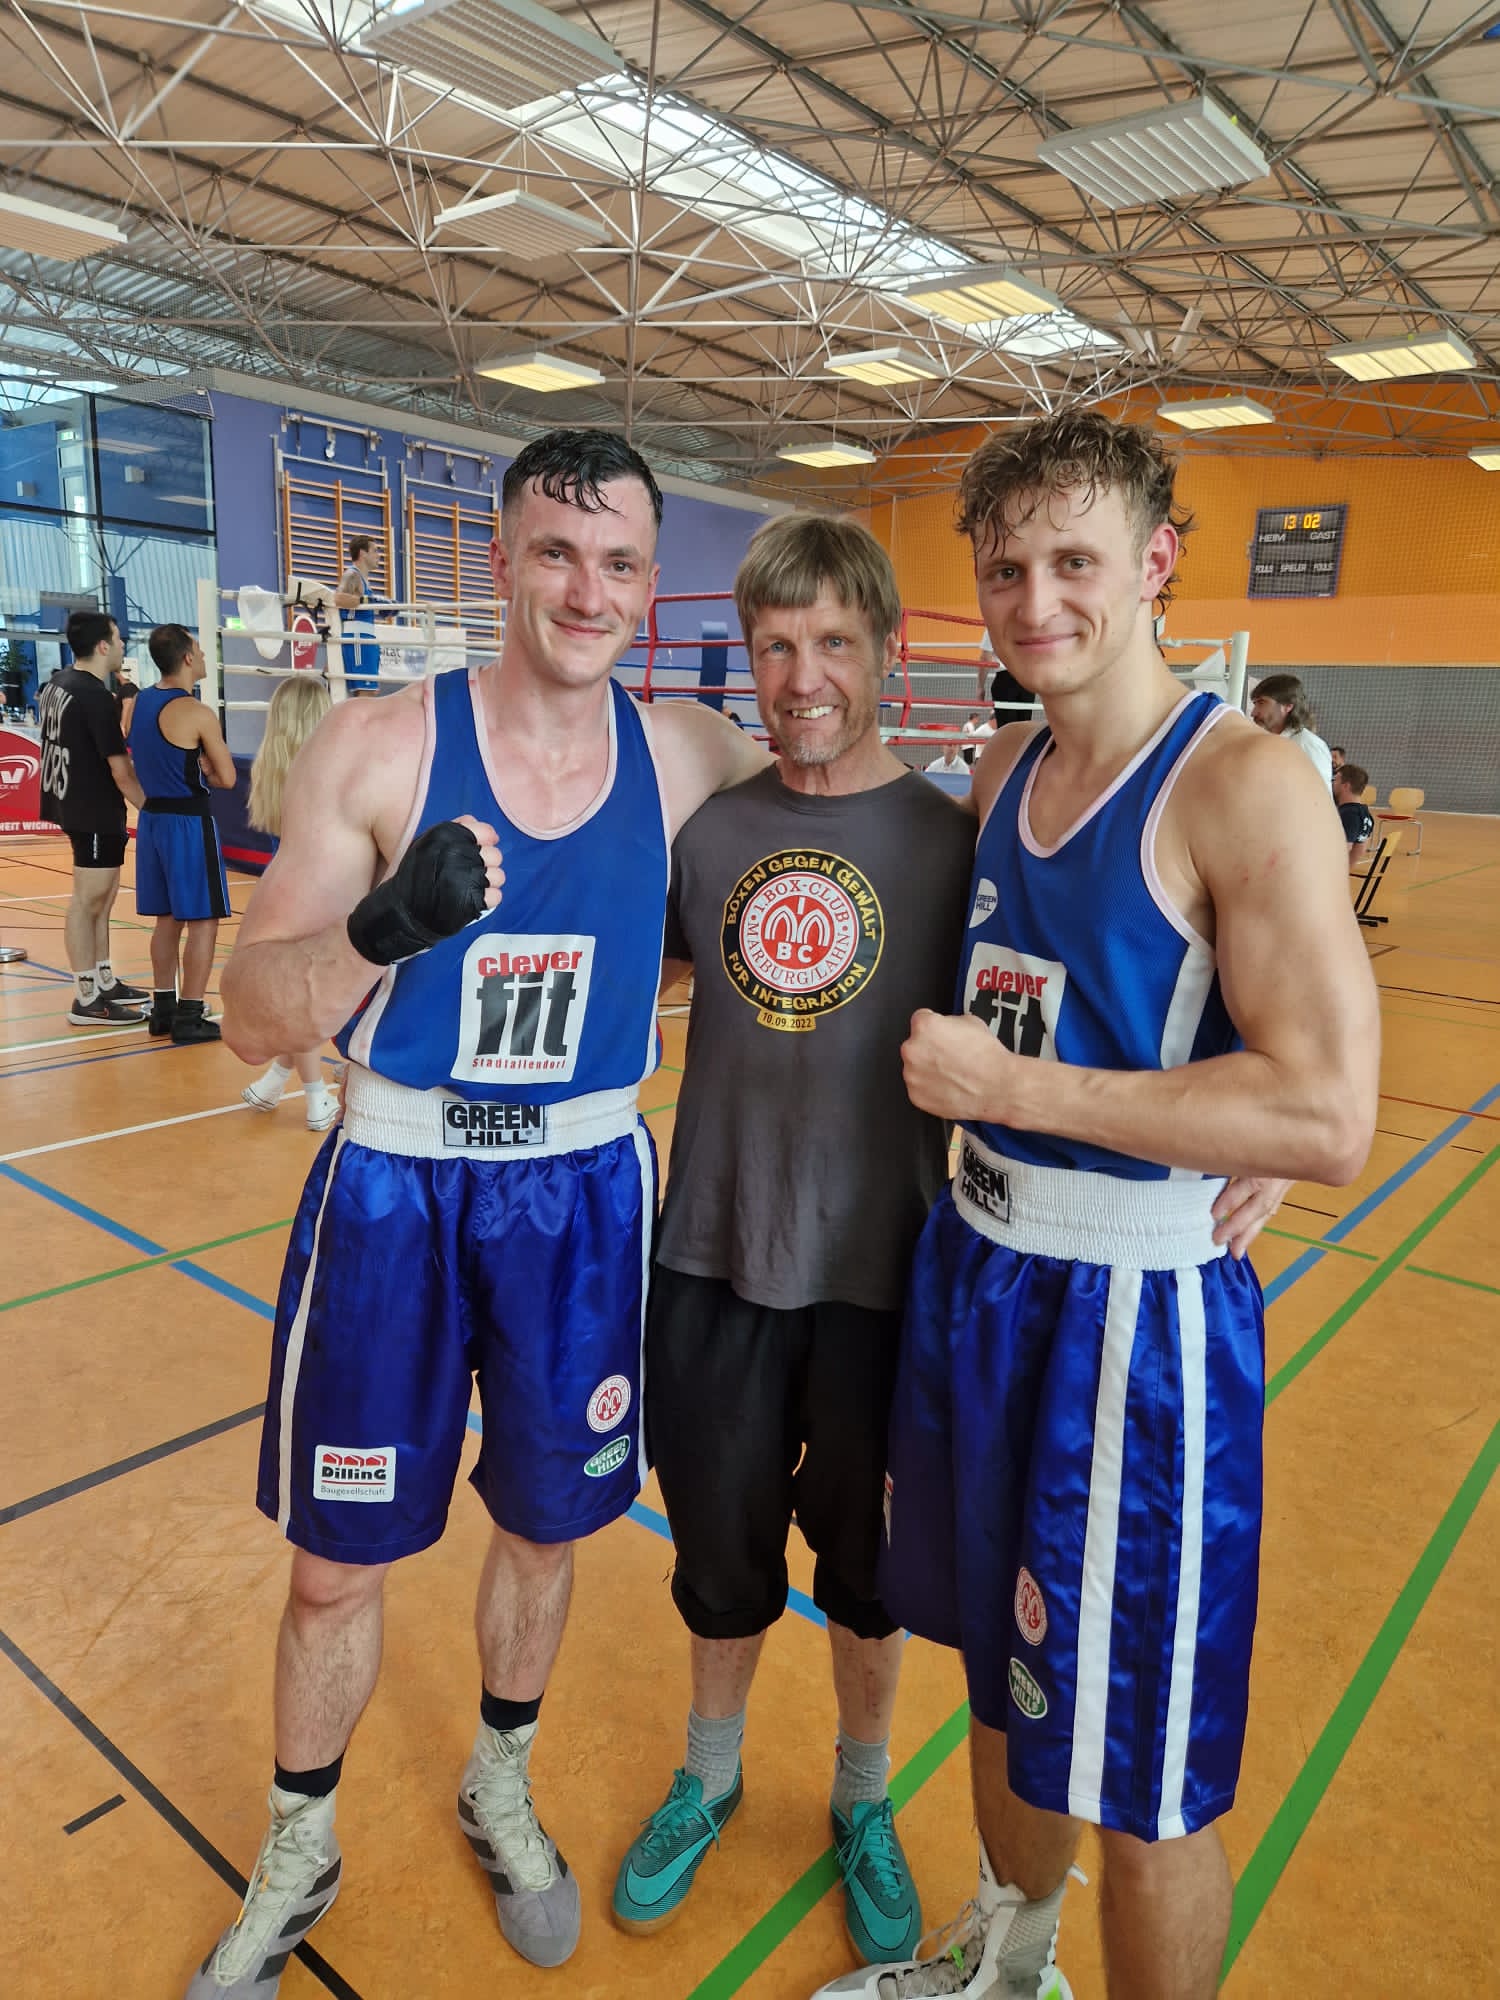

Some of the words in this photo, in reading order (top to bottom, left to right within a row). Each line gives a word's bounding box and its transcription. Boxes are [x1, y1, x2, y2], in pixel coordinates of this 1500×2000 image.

[727, 866, 767, 925] BOXEN
[768, 855, 836, 875] GEGEN
[836, 868, 877, 940] GEWALT
[477, 951, 583, 977] clever
[751, 962, 867, 1011] INTEGRATION
[975, 965, 1049, 998] clever
[476, 971, 577, 1057] fit
[762, 1012, 812, 1028] 10.09.2022
[472, 1057, 566, 1070] Stadtallendorf
[446, 1104, 541, 1129] GREEN
[465, 1130, 529, 1146] HILL
[320, 1485, 386, 1496] Baugesellschaft
